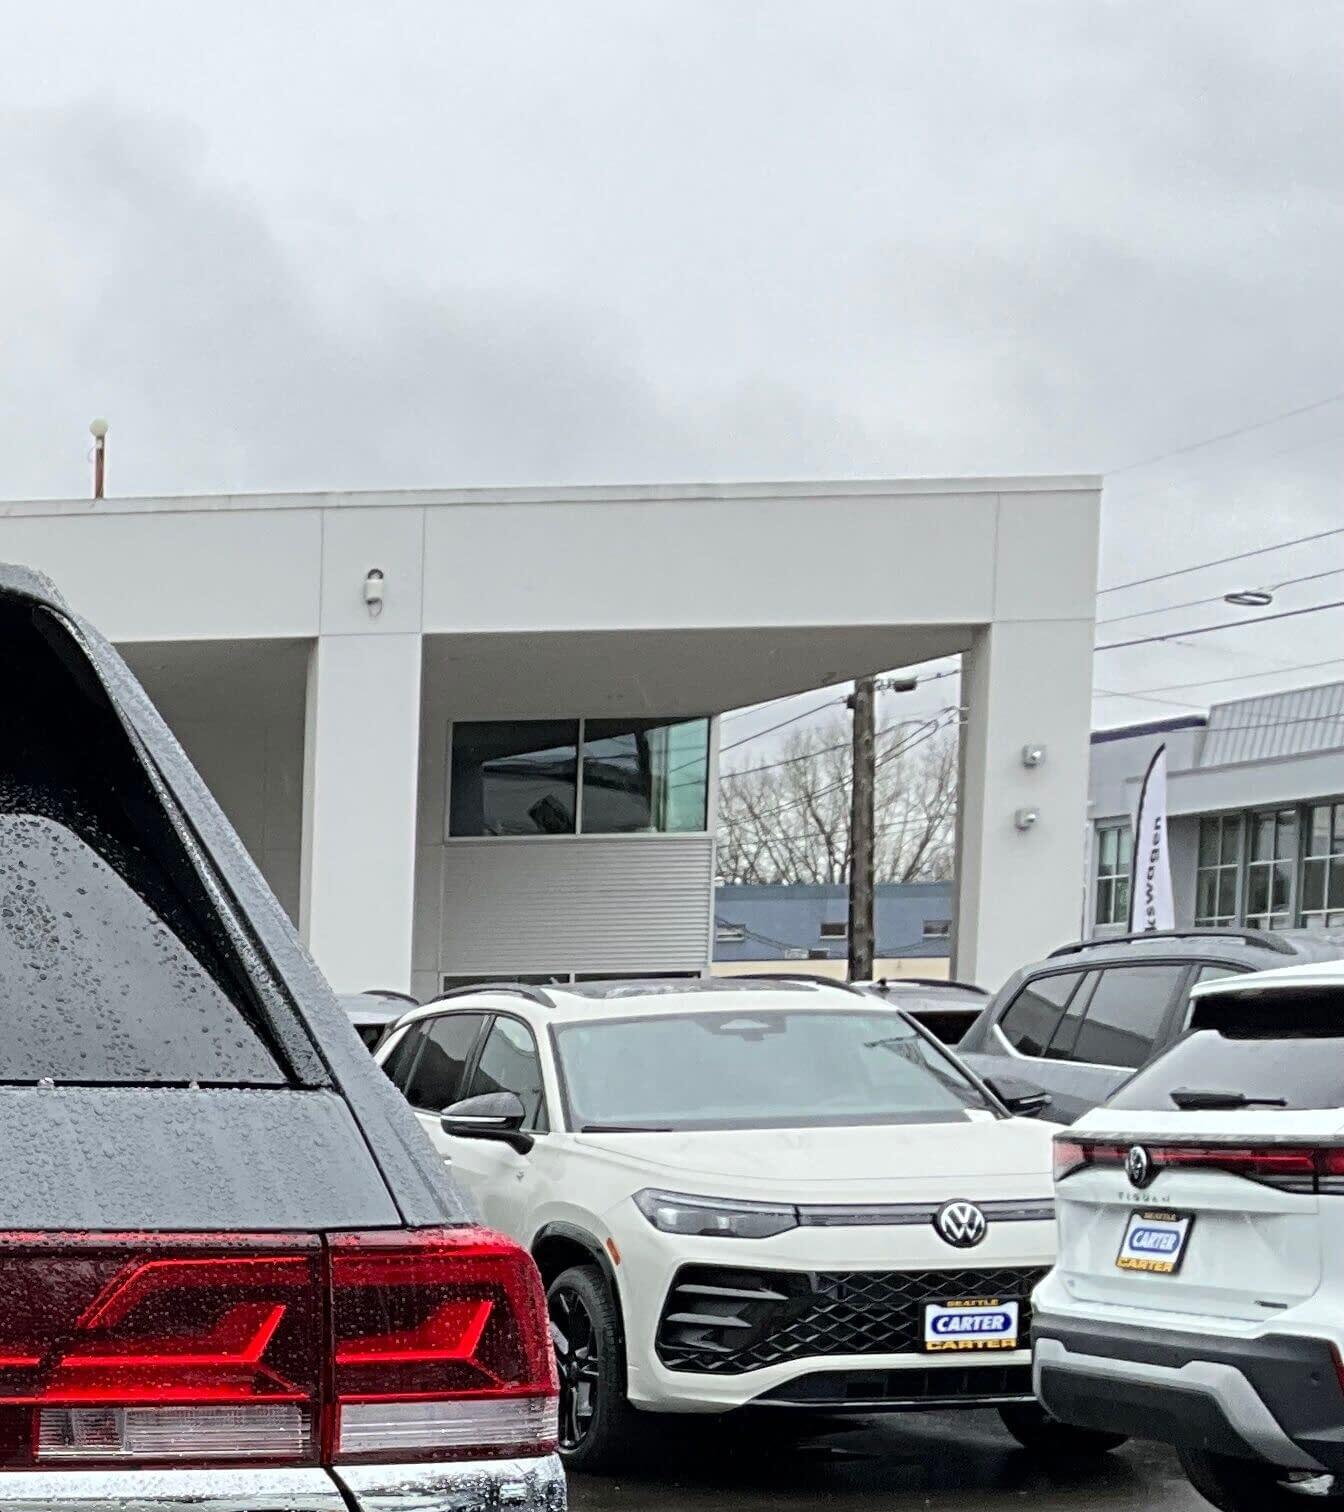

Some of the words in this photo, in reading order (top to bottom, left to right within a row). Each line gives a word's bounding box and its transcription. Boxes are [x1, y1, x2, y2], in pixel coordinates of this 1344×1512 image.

[1132, 1230, 1177, 1251] CARTER
[936, 1314, 1006, 1333] CARTER
[925, 1338, 1017, 1351] CARTER
